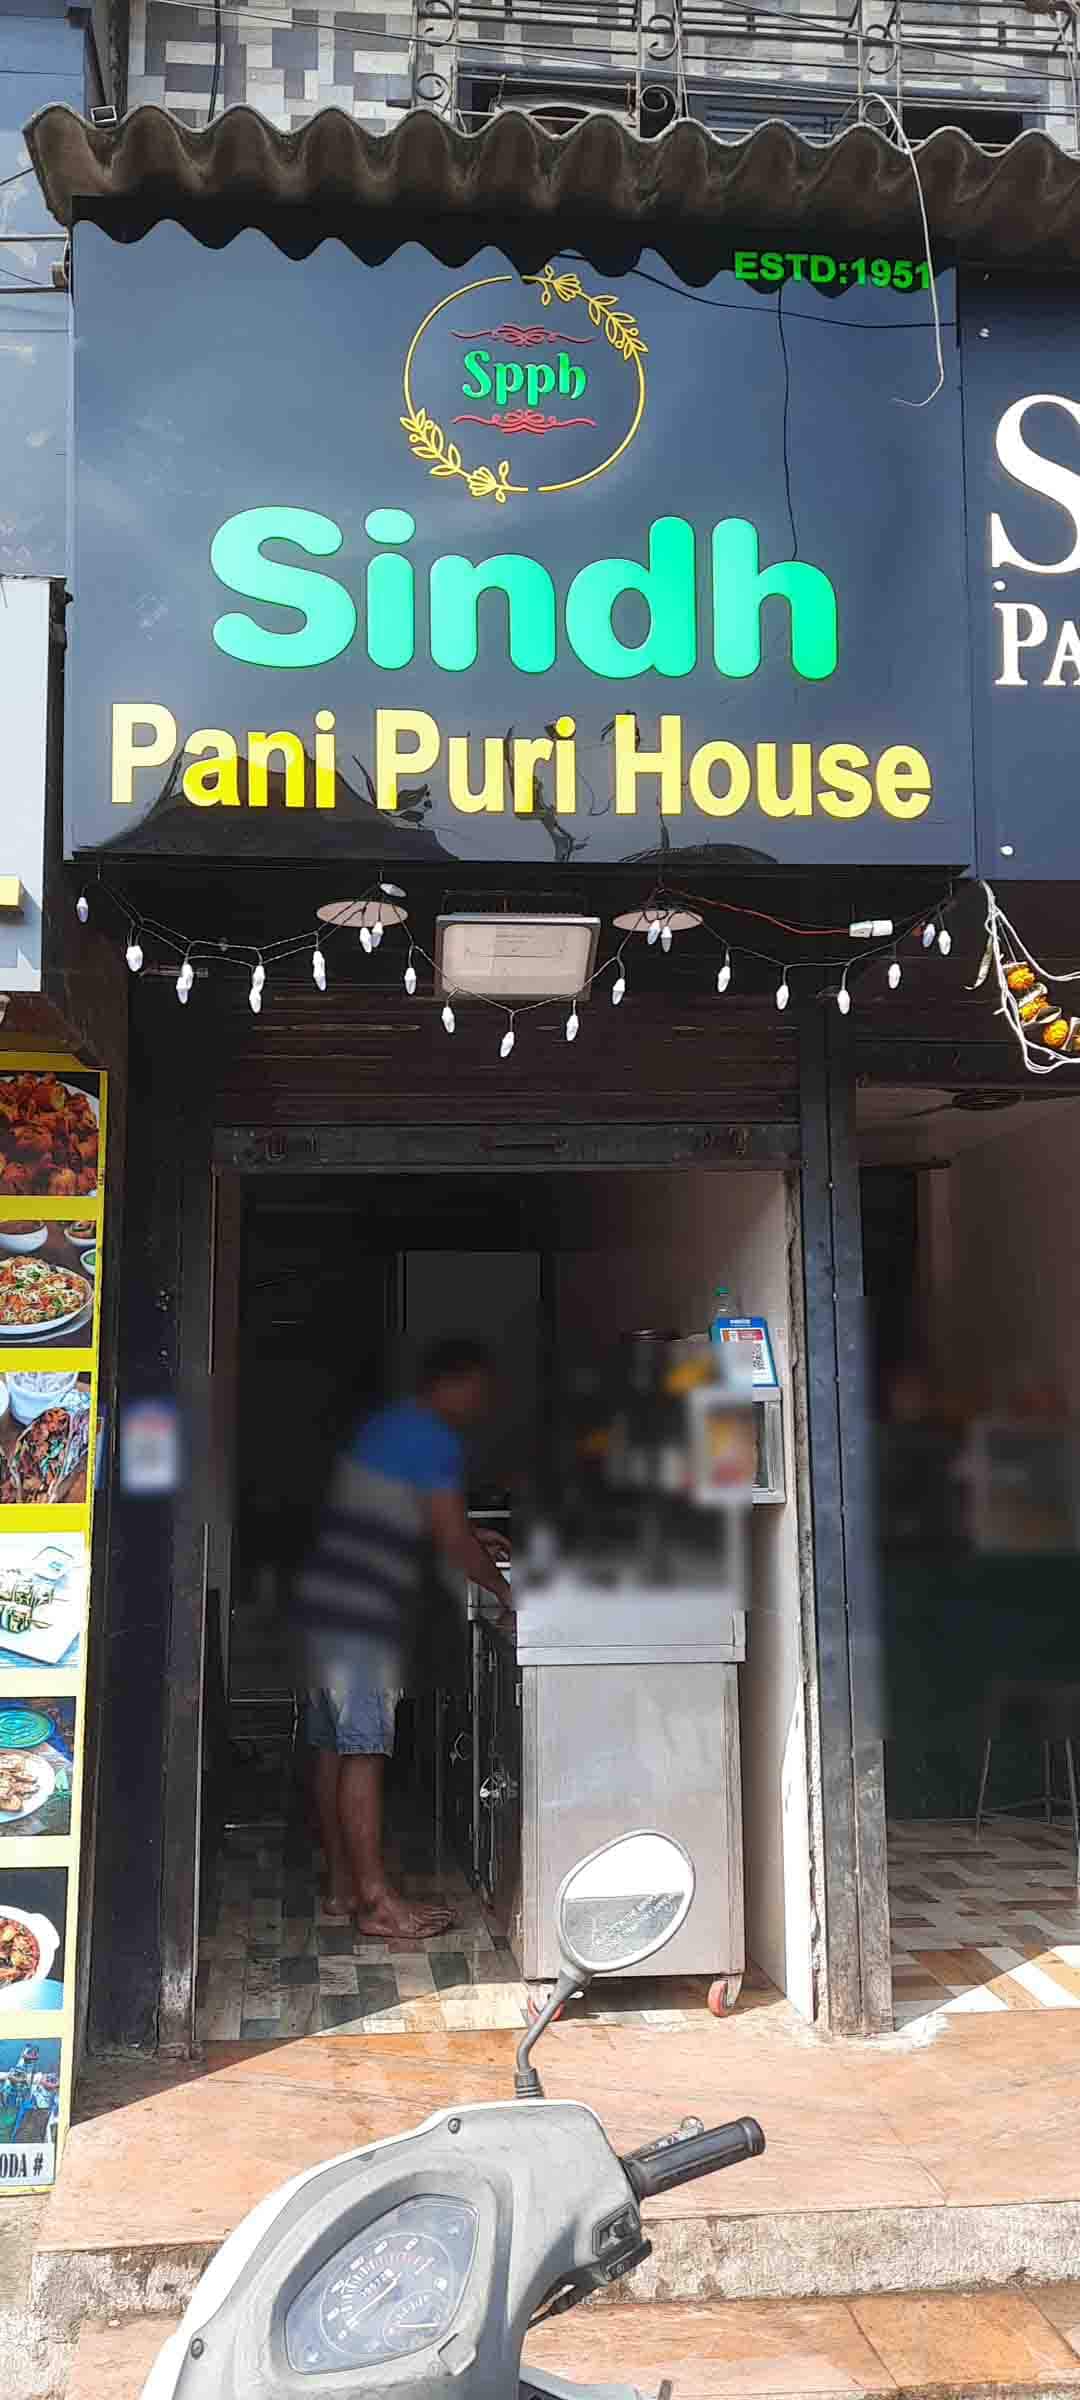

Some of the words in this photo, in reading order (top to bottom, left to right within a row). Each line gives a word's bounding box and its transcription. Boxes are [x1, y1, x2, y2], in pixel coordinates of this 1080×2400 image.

[734, 251, 932, 290] ESTD:1951
[462, 350, 588, 408] Spph
[209, 505, 839, 682] Sindh
[110, 703, 337, 809] Pani
[375, 707, 578, 815] Puri
[614, 714, 933, 820] House
